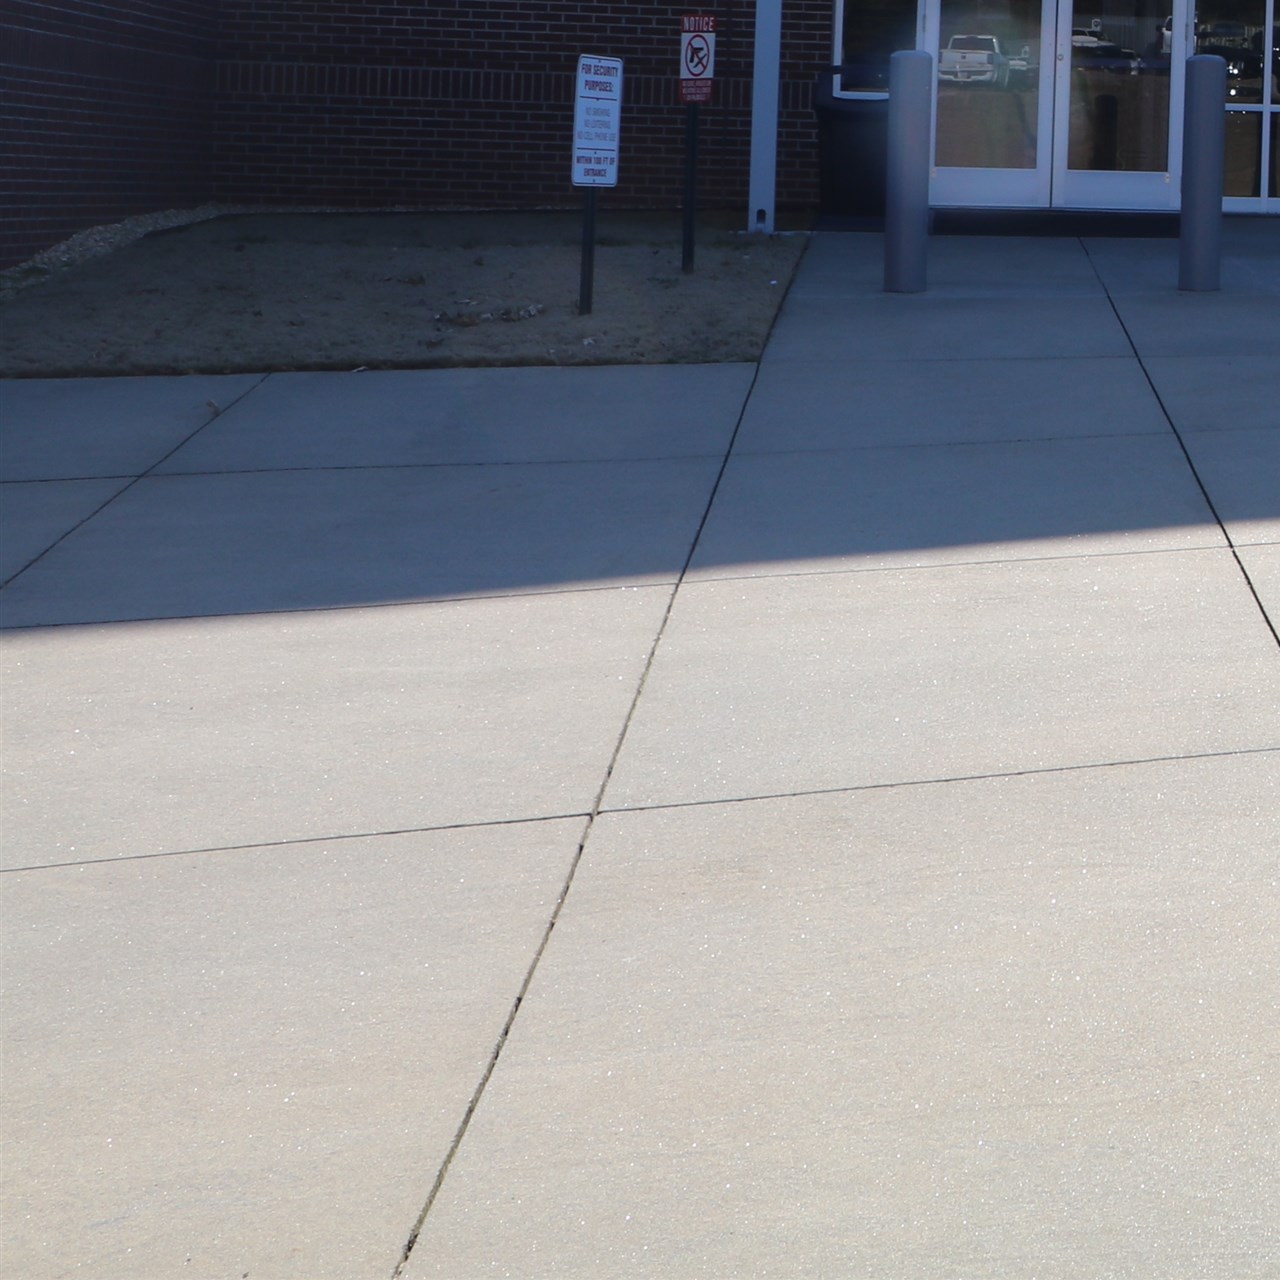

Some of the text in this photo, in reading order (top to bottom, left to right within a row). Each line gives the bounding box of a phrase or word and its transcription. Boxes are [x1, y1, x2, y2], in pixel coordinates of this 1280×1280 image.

[683, 16, 714, 31] NOTICE
[582, 63, 618, 77] FOR SECURITY
[584, 80, 614, 92] PURPOSES:
[576, 155, 592, 165] WITHIN
[583, 168, 607, 177] ENTRANCE
